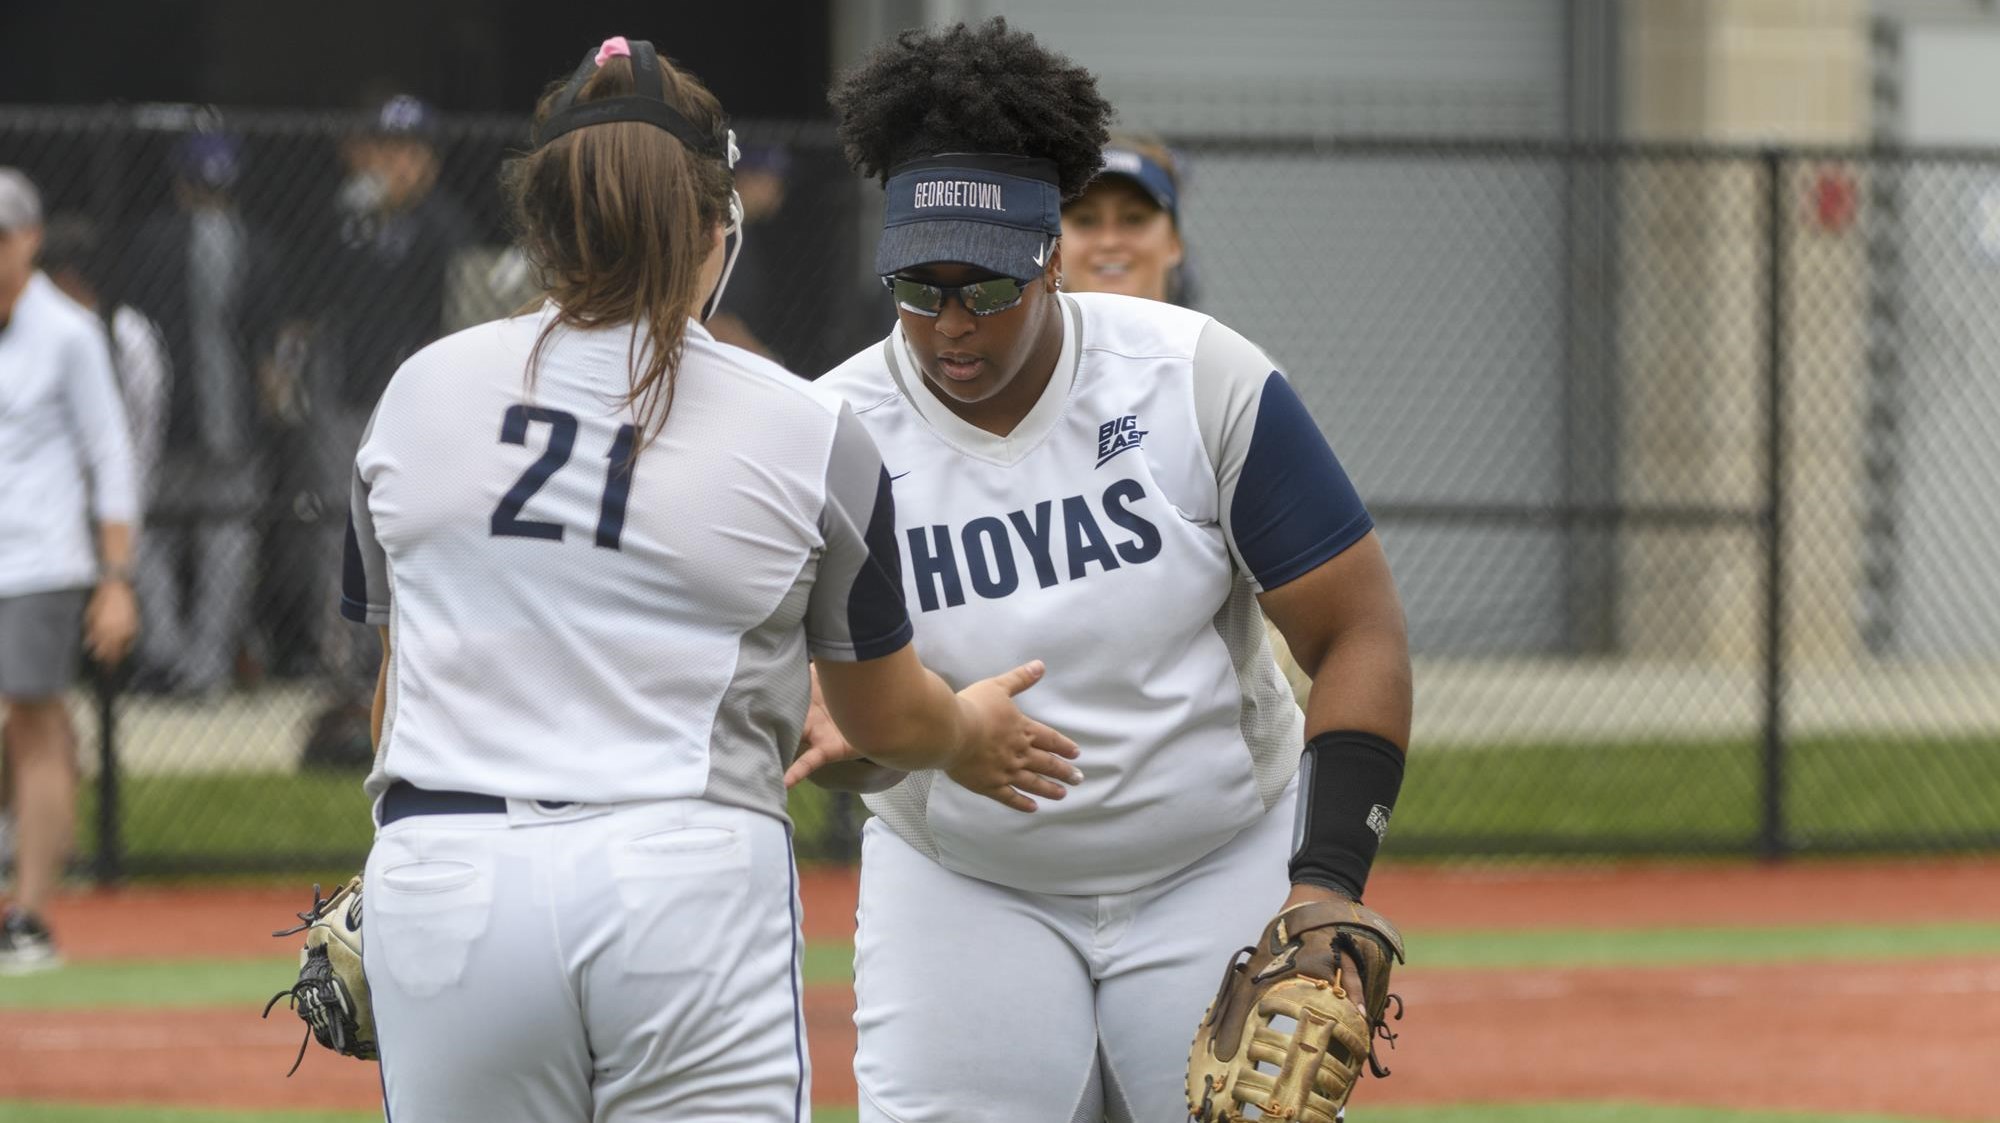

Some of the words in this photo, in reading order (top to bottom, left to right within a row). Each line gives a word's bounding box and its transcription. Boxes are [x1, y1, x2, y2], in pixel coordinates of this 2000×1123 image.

[914, 180, 1002, 211] GEORGETOWN
[1098, 414, 1137, 443] BIG
[1097, 430, 1149, 460] EAST
[490, 404, 644, 551] 21
[906, 478, 1162, 613] HOYAS
